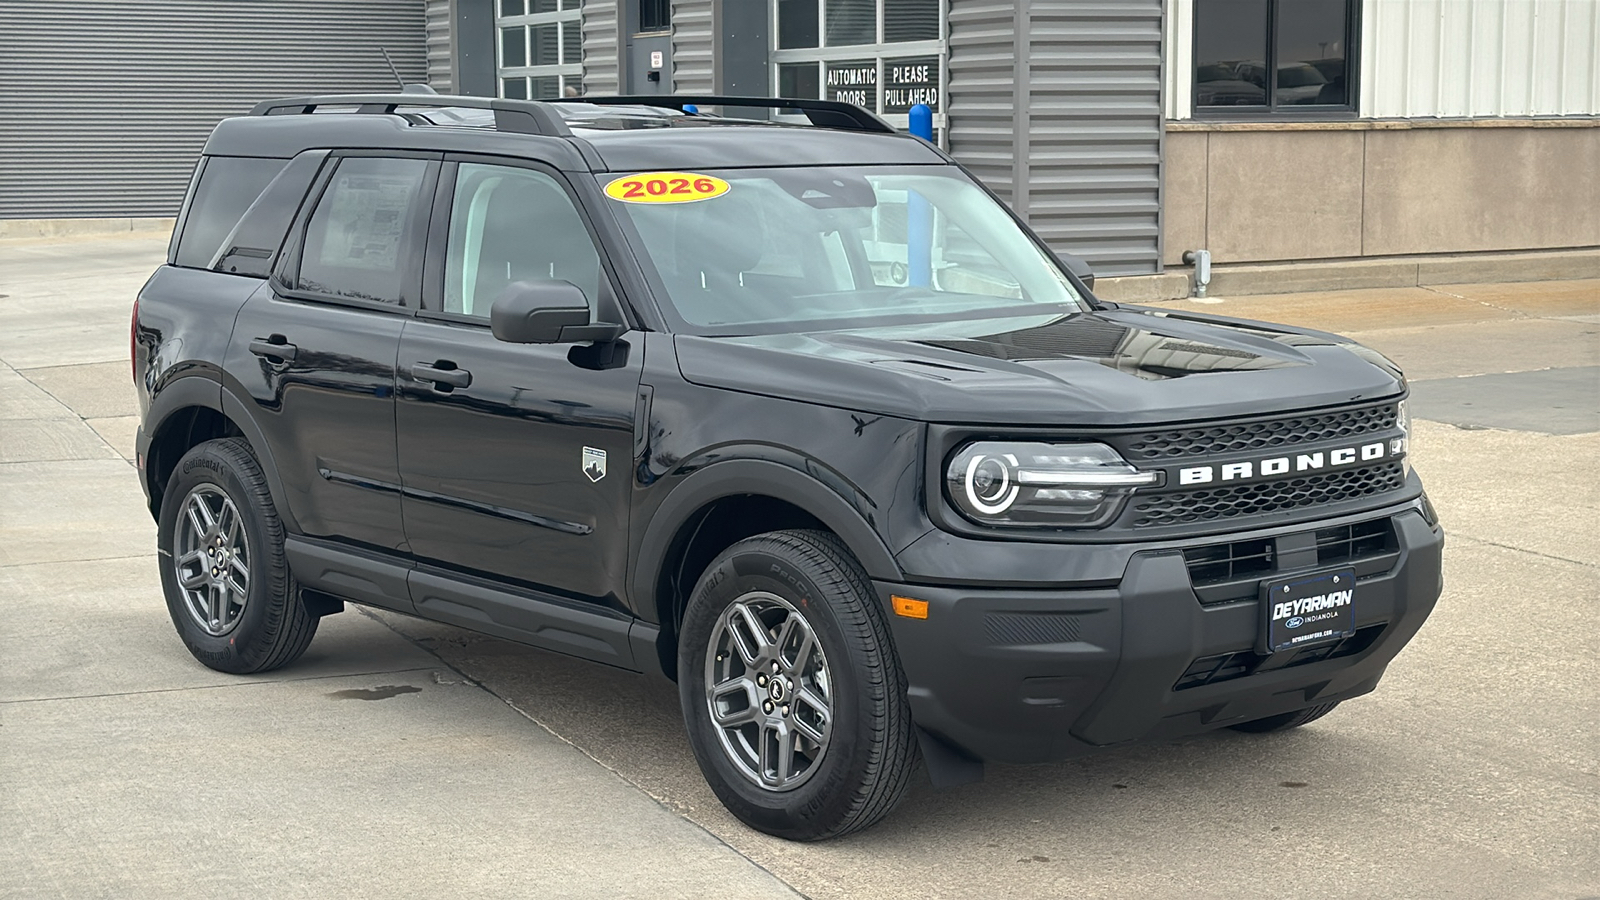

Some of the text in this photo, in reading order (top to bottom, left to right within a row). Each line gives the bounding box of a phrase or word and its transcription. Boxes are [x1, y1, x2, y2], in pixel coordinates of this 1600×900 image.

[827, 68, 876, 86] AUTOMATIC
[893, 65, 929, 83] PLEASE
[836, 90, 866, 106] DOORS
[885, 88, 938, 106] PULL AHEAD
[622, 178, 716, 198] 2026
[183, 457, 220, 474] Continental
[1179, 442, 1385, 486] BRONCO
[1272, 589, 1353, 620] DEYARMAN
[1304, 611, 1339, 623] INDIANOLA
